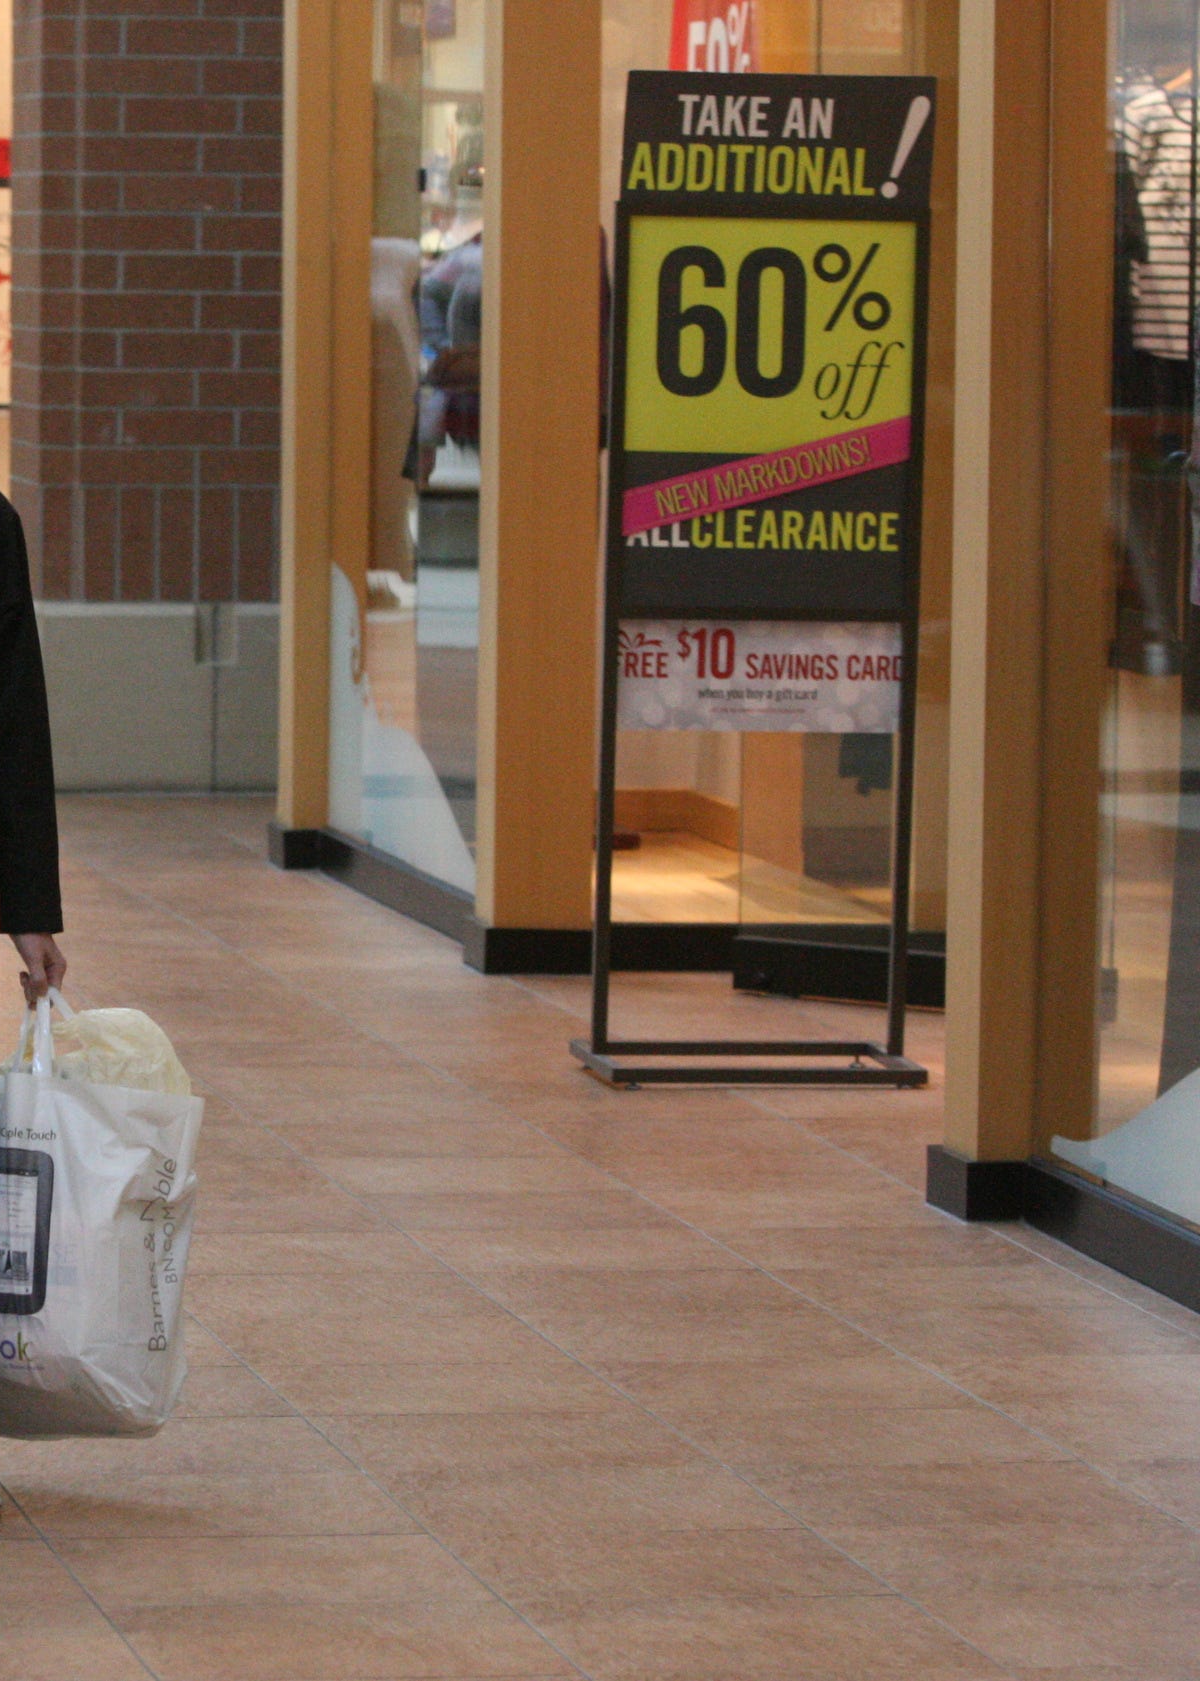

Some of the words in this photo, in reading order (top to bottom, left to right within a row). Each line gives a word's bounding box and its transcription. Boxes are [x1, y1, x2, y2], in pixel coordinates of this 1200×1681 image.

[679, 94, 771, 138] TAKE
[781, 97, 835, 140] AN
[627, 141, 876, 197] ADDITIONAL
[656, 242, 891, 399] 60%
[813, 340, 906, 421] off
[654, 479, 710, 518] NEW
[713, 435, 872, 501] MARKDOWNS!
[691, 509, 900, 552] CLEARANCE
[618, 651, 669, 679] REE
[676, 627, 736, 680] $10
[745, 653, 839, 681] SAVINGS
[26, 1127, 57, 1141] Touch
[139, 1157, 178, 1223] Nble
